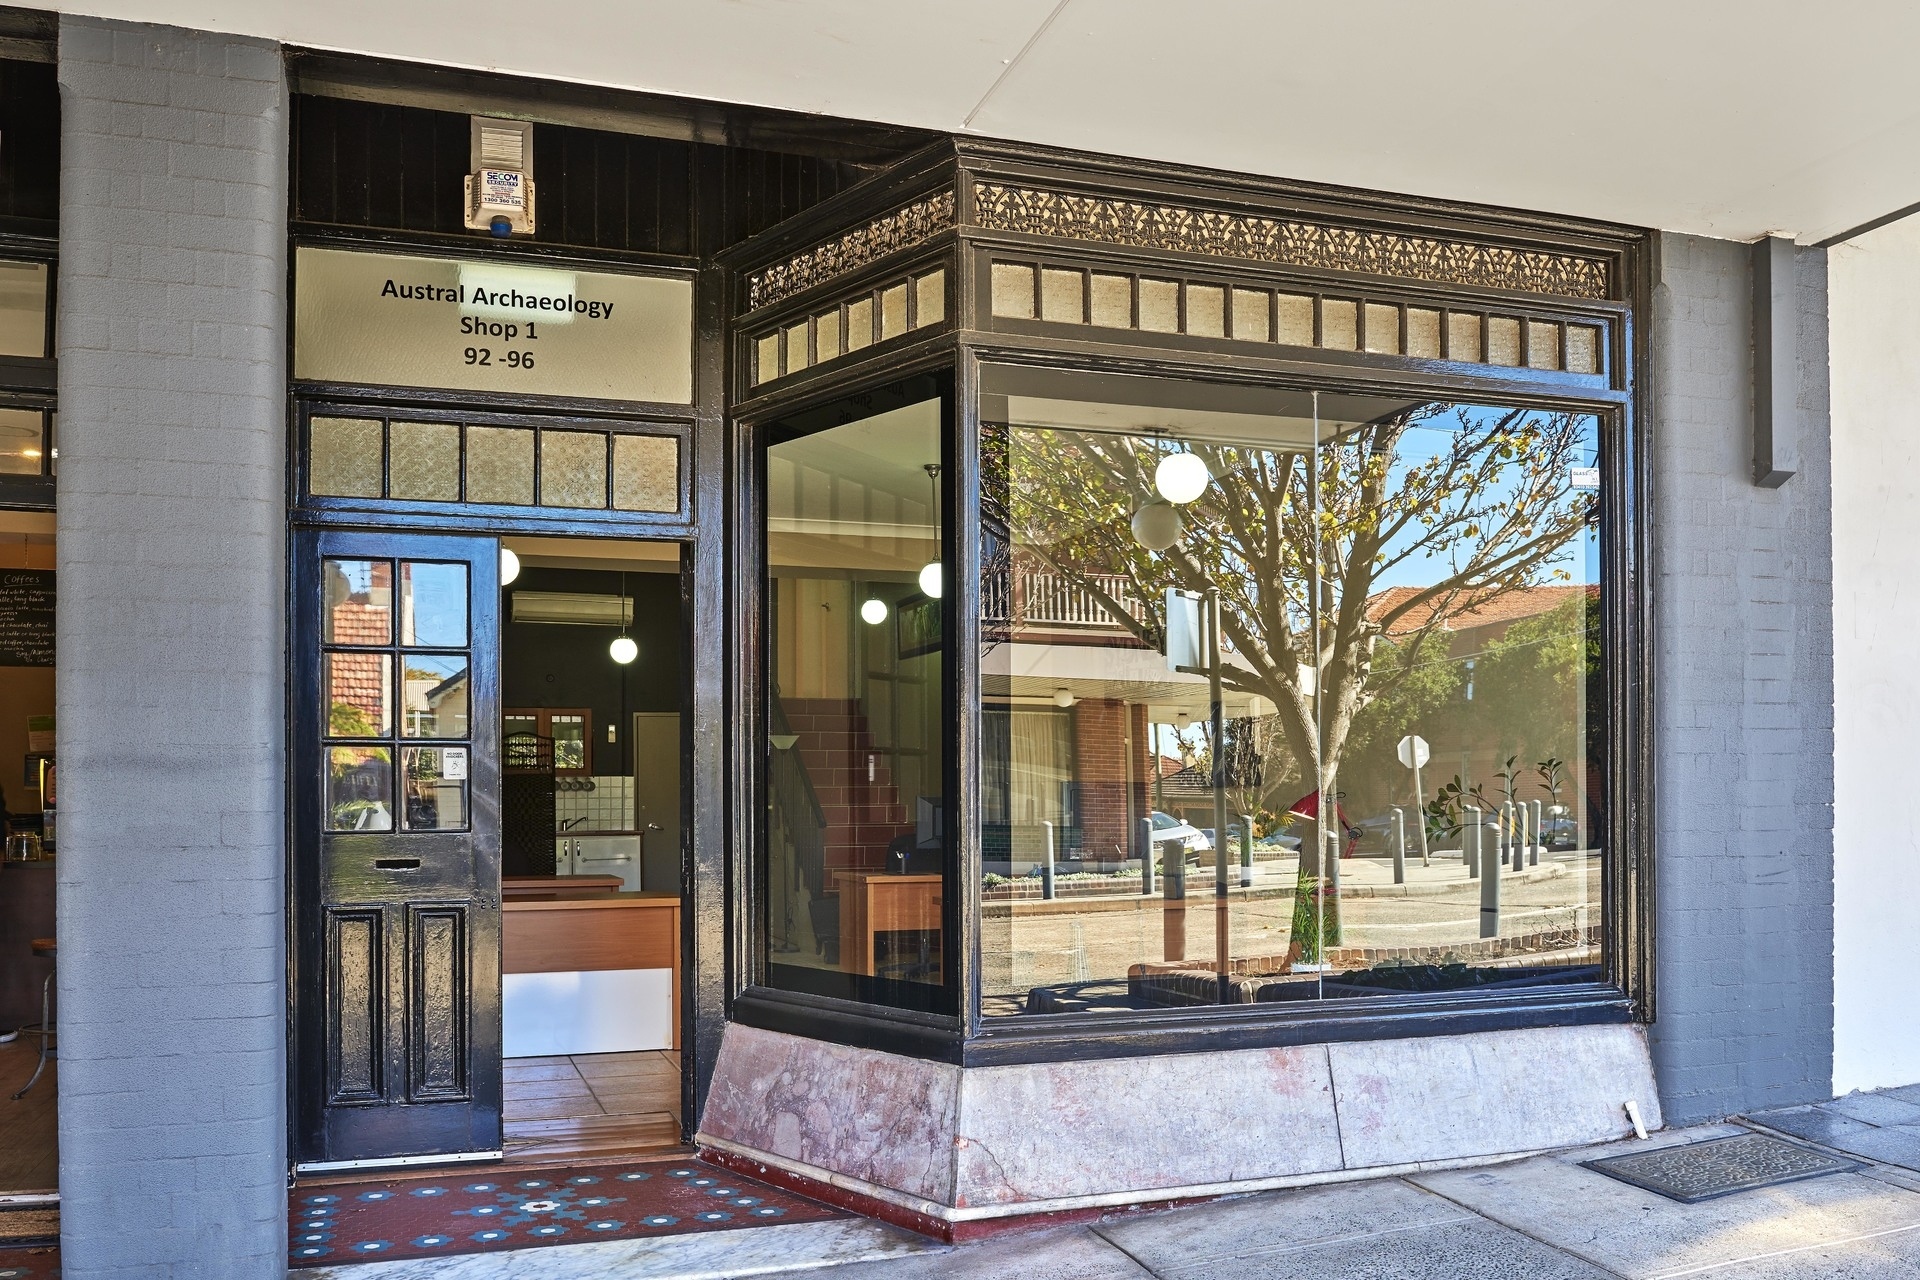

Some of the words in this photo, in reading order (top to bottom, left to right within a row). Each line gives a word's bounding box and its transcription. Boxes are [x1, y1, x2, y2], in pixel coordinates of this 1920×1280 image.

[487, 172, 518, 181] SECOM
[381, 279, 465, 303] Austral
[472, 287, 614, 320] Archaeology
[460, 316, 518, 342] Shop
[526, 322, 538, 340] 1
[464, 347, 492, 367] 92
[499, 350, 535, 369] -96
[4, 574, 40, 585] Coffees
